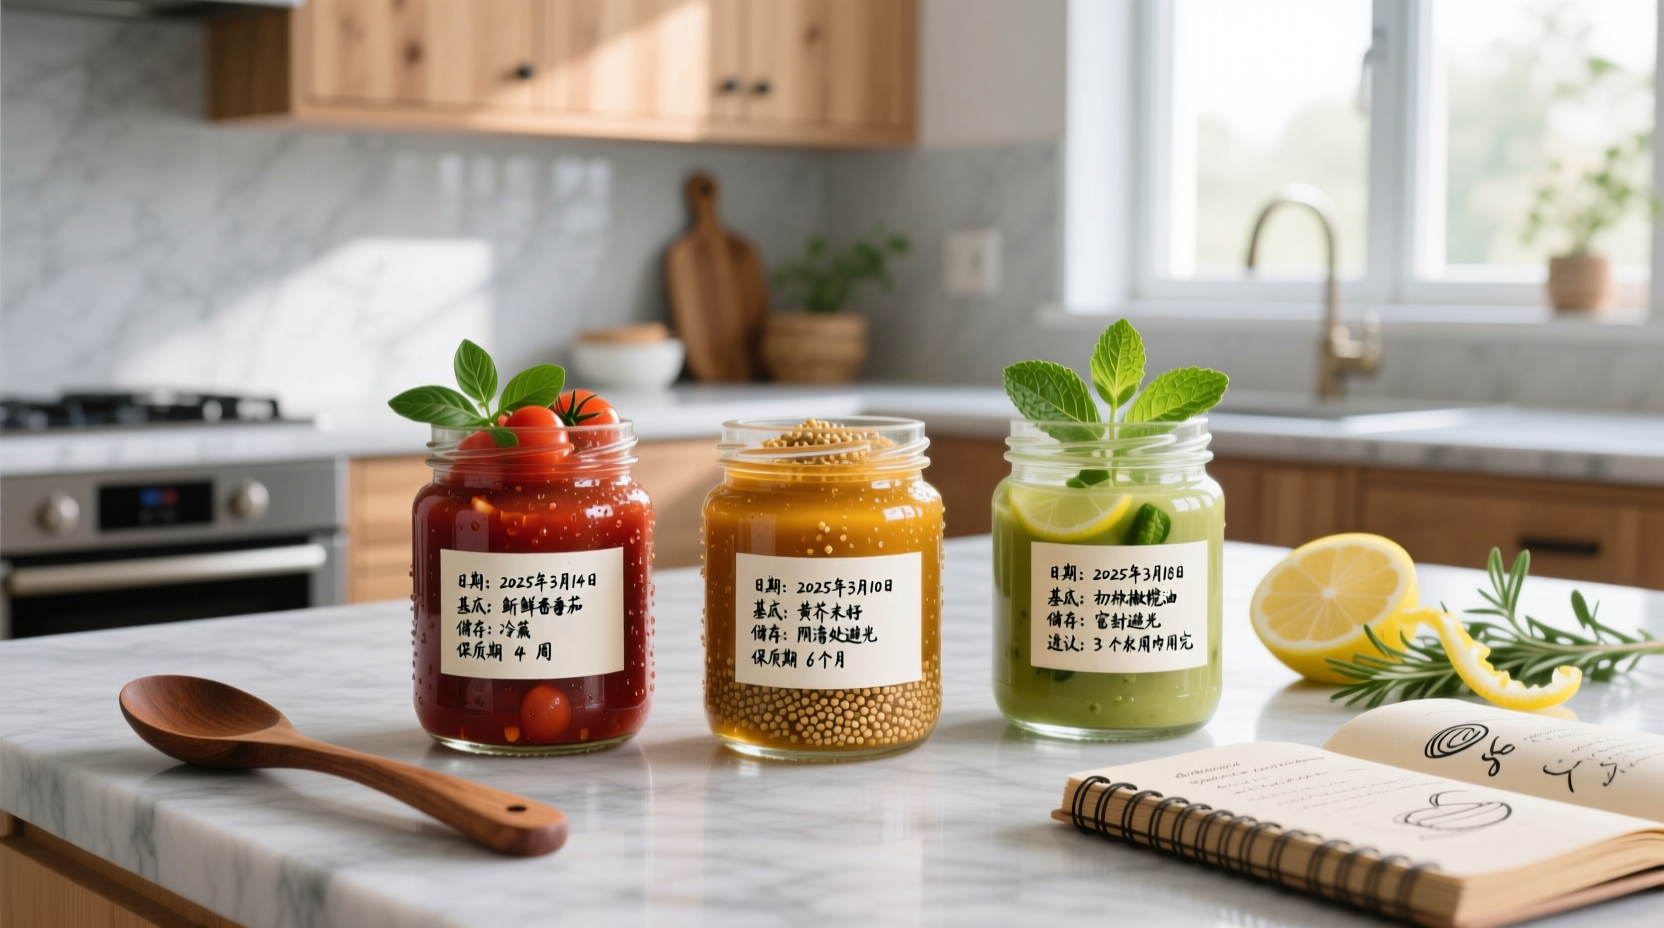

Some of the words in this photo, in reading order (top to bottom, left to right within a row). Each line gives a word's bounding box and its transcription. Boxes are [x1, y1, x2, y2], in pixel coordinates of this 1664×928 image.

[500, 573, 597, 592] 2025年3月14日
[796, 578, 893, 598] 2025年3月10日
